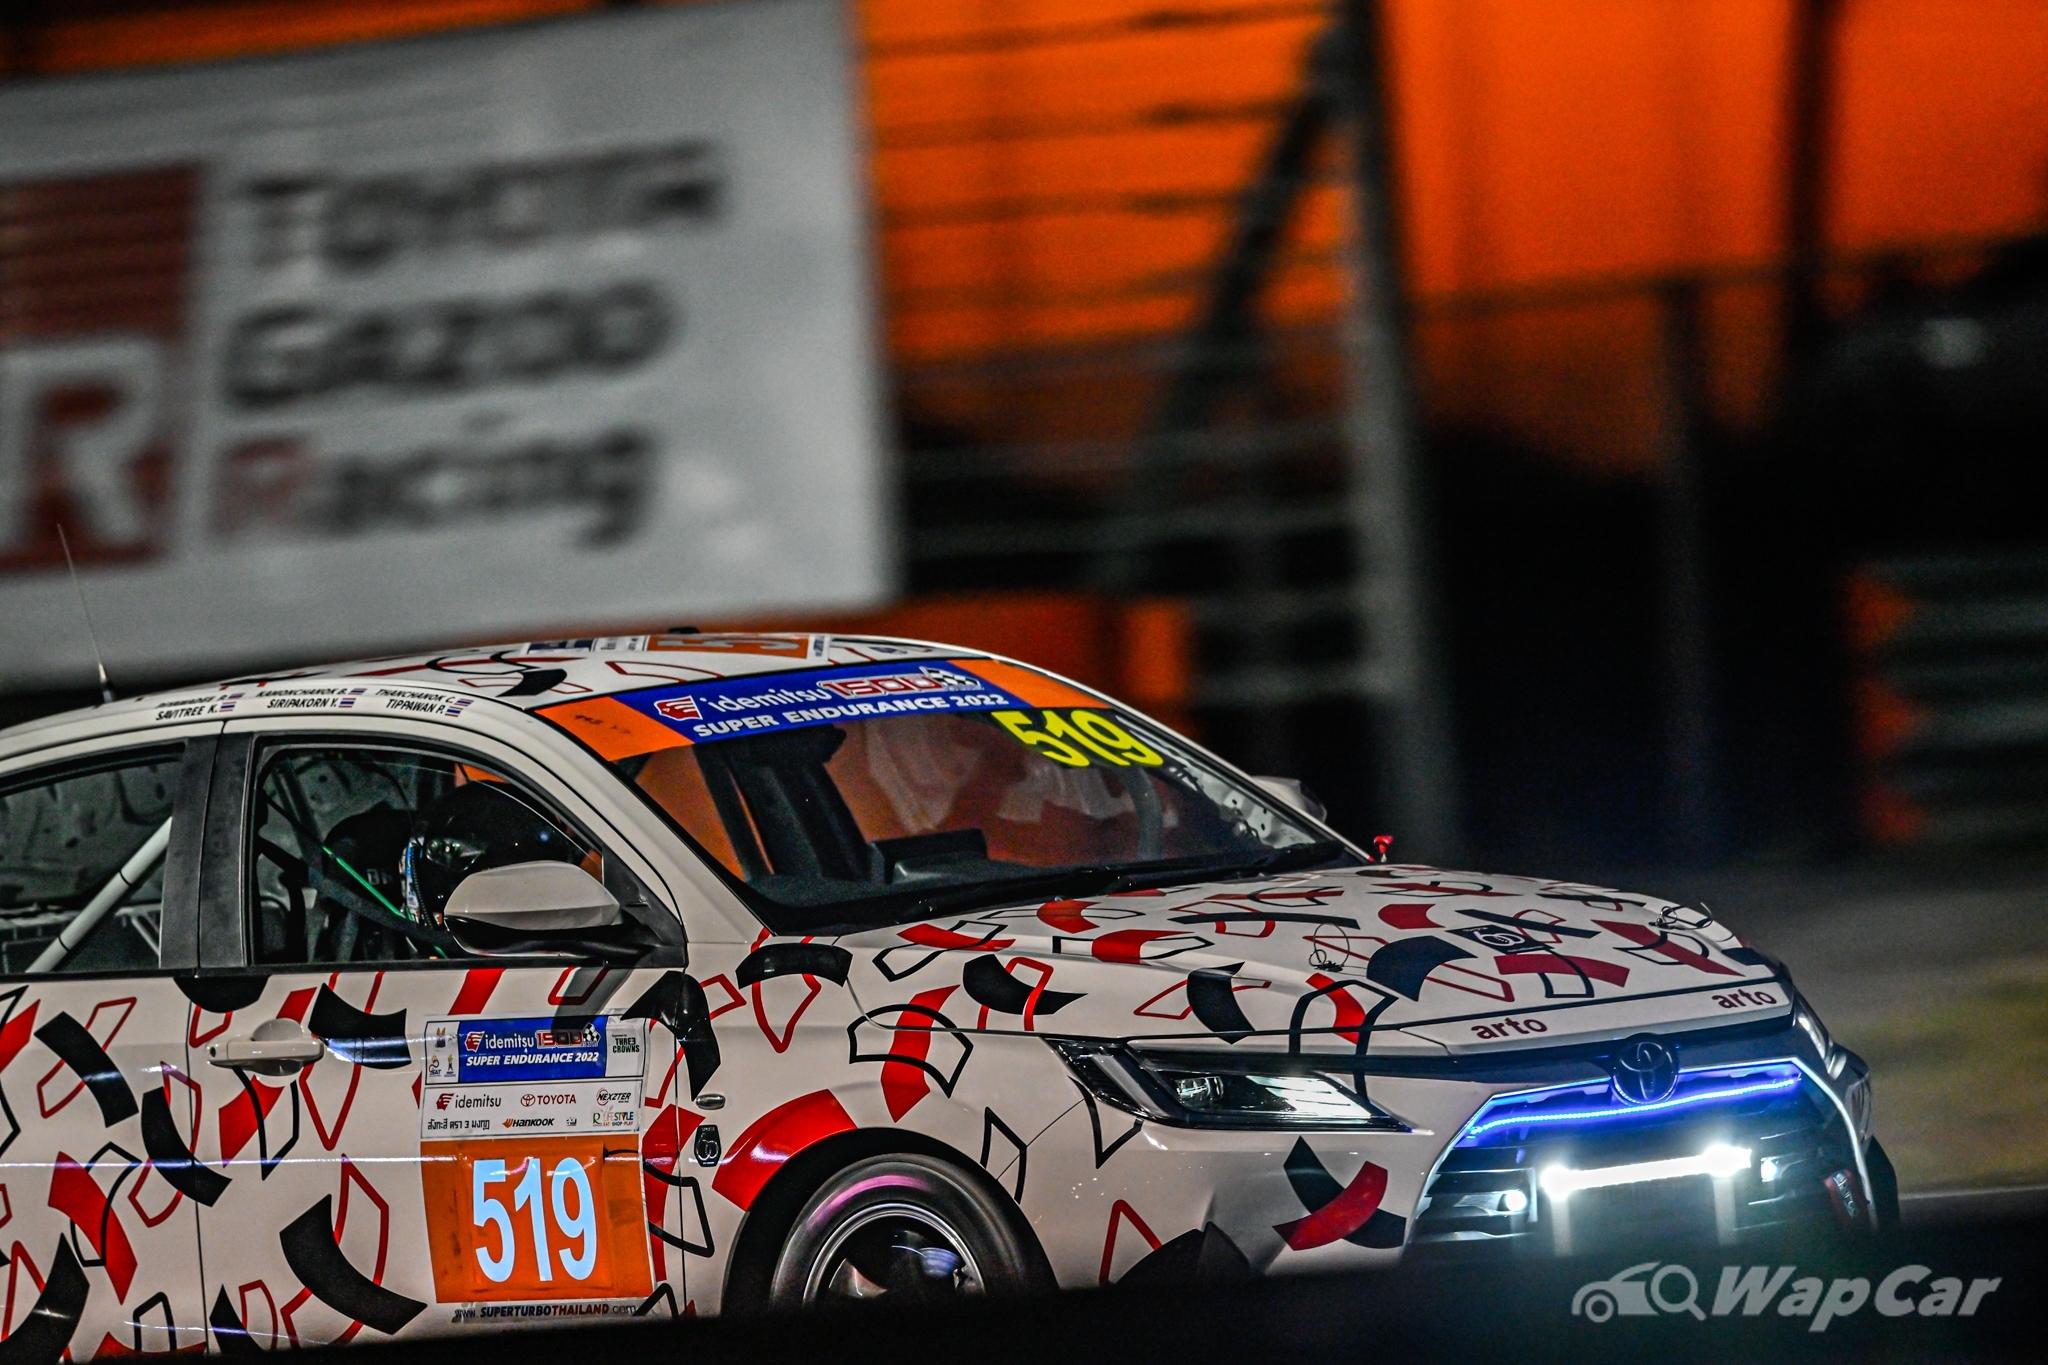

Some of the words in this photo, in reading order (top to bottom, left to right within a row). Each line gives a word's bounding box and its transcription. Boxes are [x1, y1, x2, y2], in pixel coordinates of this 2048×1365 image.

[700, 688, 833, 712] idemitsu
[818, 672, 945, 699] 1500
[267, 698, 328, 708] SIRIPAKORN
[386, 699, 437, 713] TIPPAWAN
[156, 705, 206, 720] SAVITREE
[693, 714, 780, 737] SUPER
[782, 697, 950, 724] ENDURANCE
[950, 694, 1010, 707] 2022
[991, 710, 1164, 767] 519
[1712, 986, 1778, 1009] arto
[1470, 1015, 1548, 1041] arto
[485, 1033, 534, 1049] idemitsu
[613, 1045, 640, 1053] CROWNS
[466, 1054, 500, 1066] SUPER
[503, 1053, 574, 1065] ENDURANCE
[574, 1052, 599, 1062] 2022
[455, 1093, 501, 1109] idemitsu
[536, 1094, 577, 1105] TOYOTA
[597, 1092, 632, 1101] NEXZTER
[473, 1156, 598, 1283] 519
